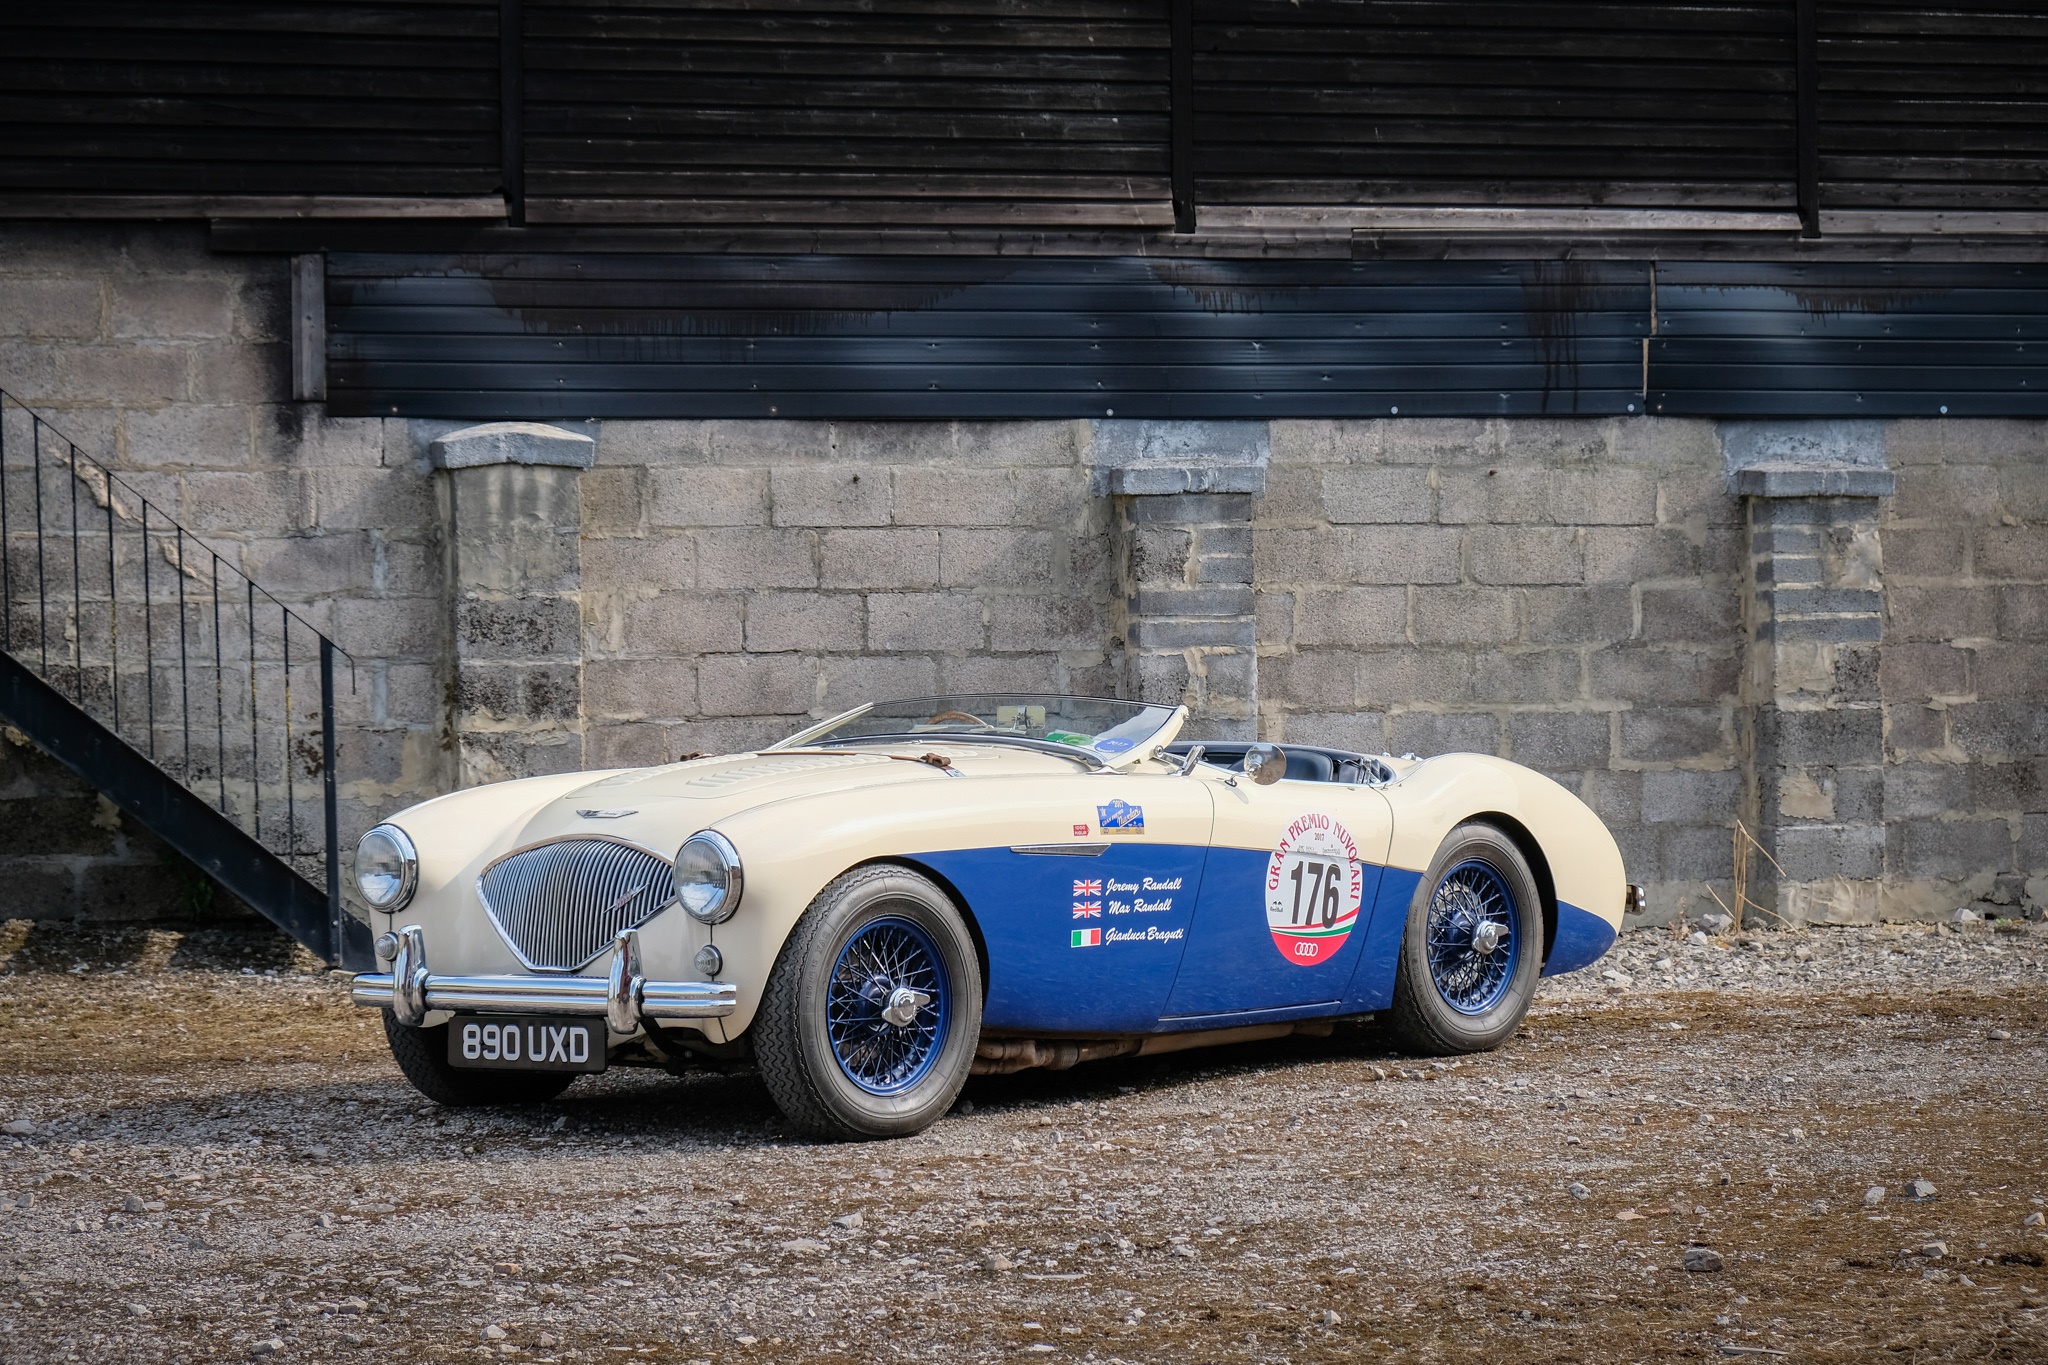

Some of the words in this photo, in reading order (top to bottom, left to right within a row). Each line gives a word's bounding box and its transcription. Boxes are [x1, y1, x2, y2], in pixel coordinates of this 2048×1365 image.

[1314, 832, 1325, 842] 2017
[1268, 838, 1292, 891] GRAN
[1288, 813, 1330, 841] PREMIO
[1332, 821, 1361, 900] NUVOLARI
[1105, 877, 1140, 897] Jeremy
[1142, 876, 1183, 891] Randall
[1290, 860, 1342, 930] 176
[1108, 901, 1131, 916] Max
[1133, 897, 1173, 913] Randall
[1105, 926, 1147, 946] Gianluca
[1147, 926, 1184, 945] Braguti
[462, 1023, 521, 1062] 890
[527, 1025, 589, 1064] UXD
